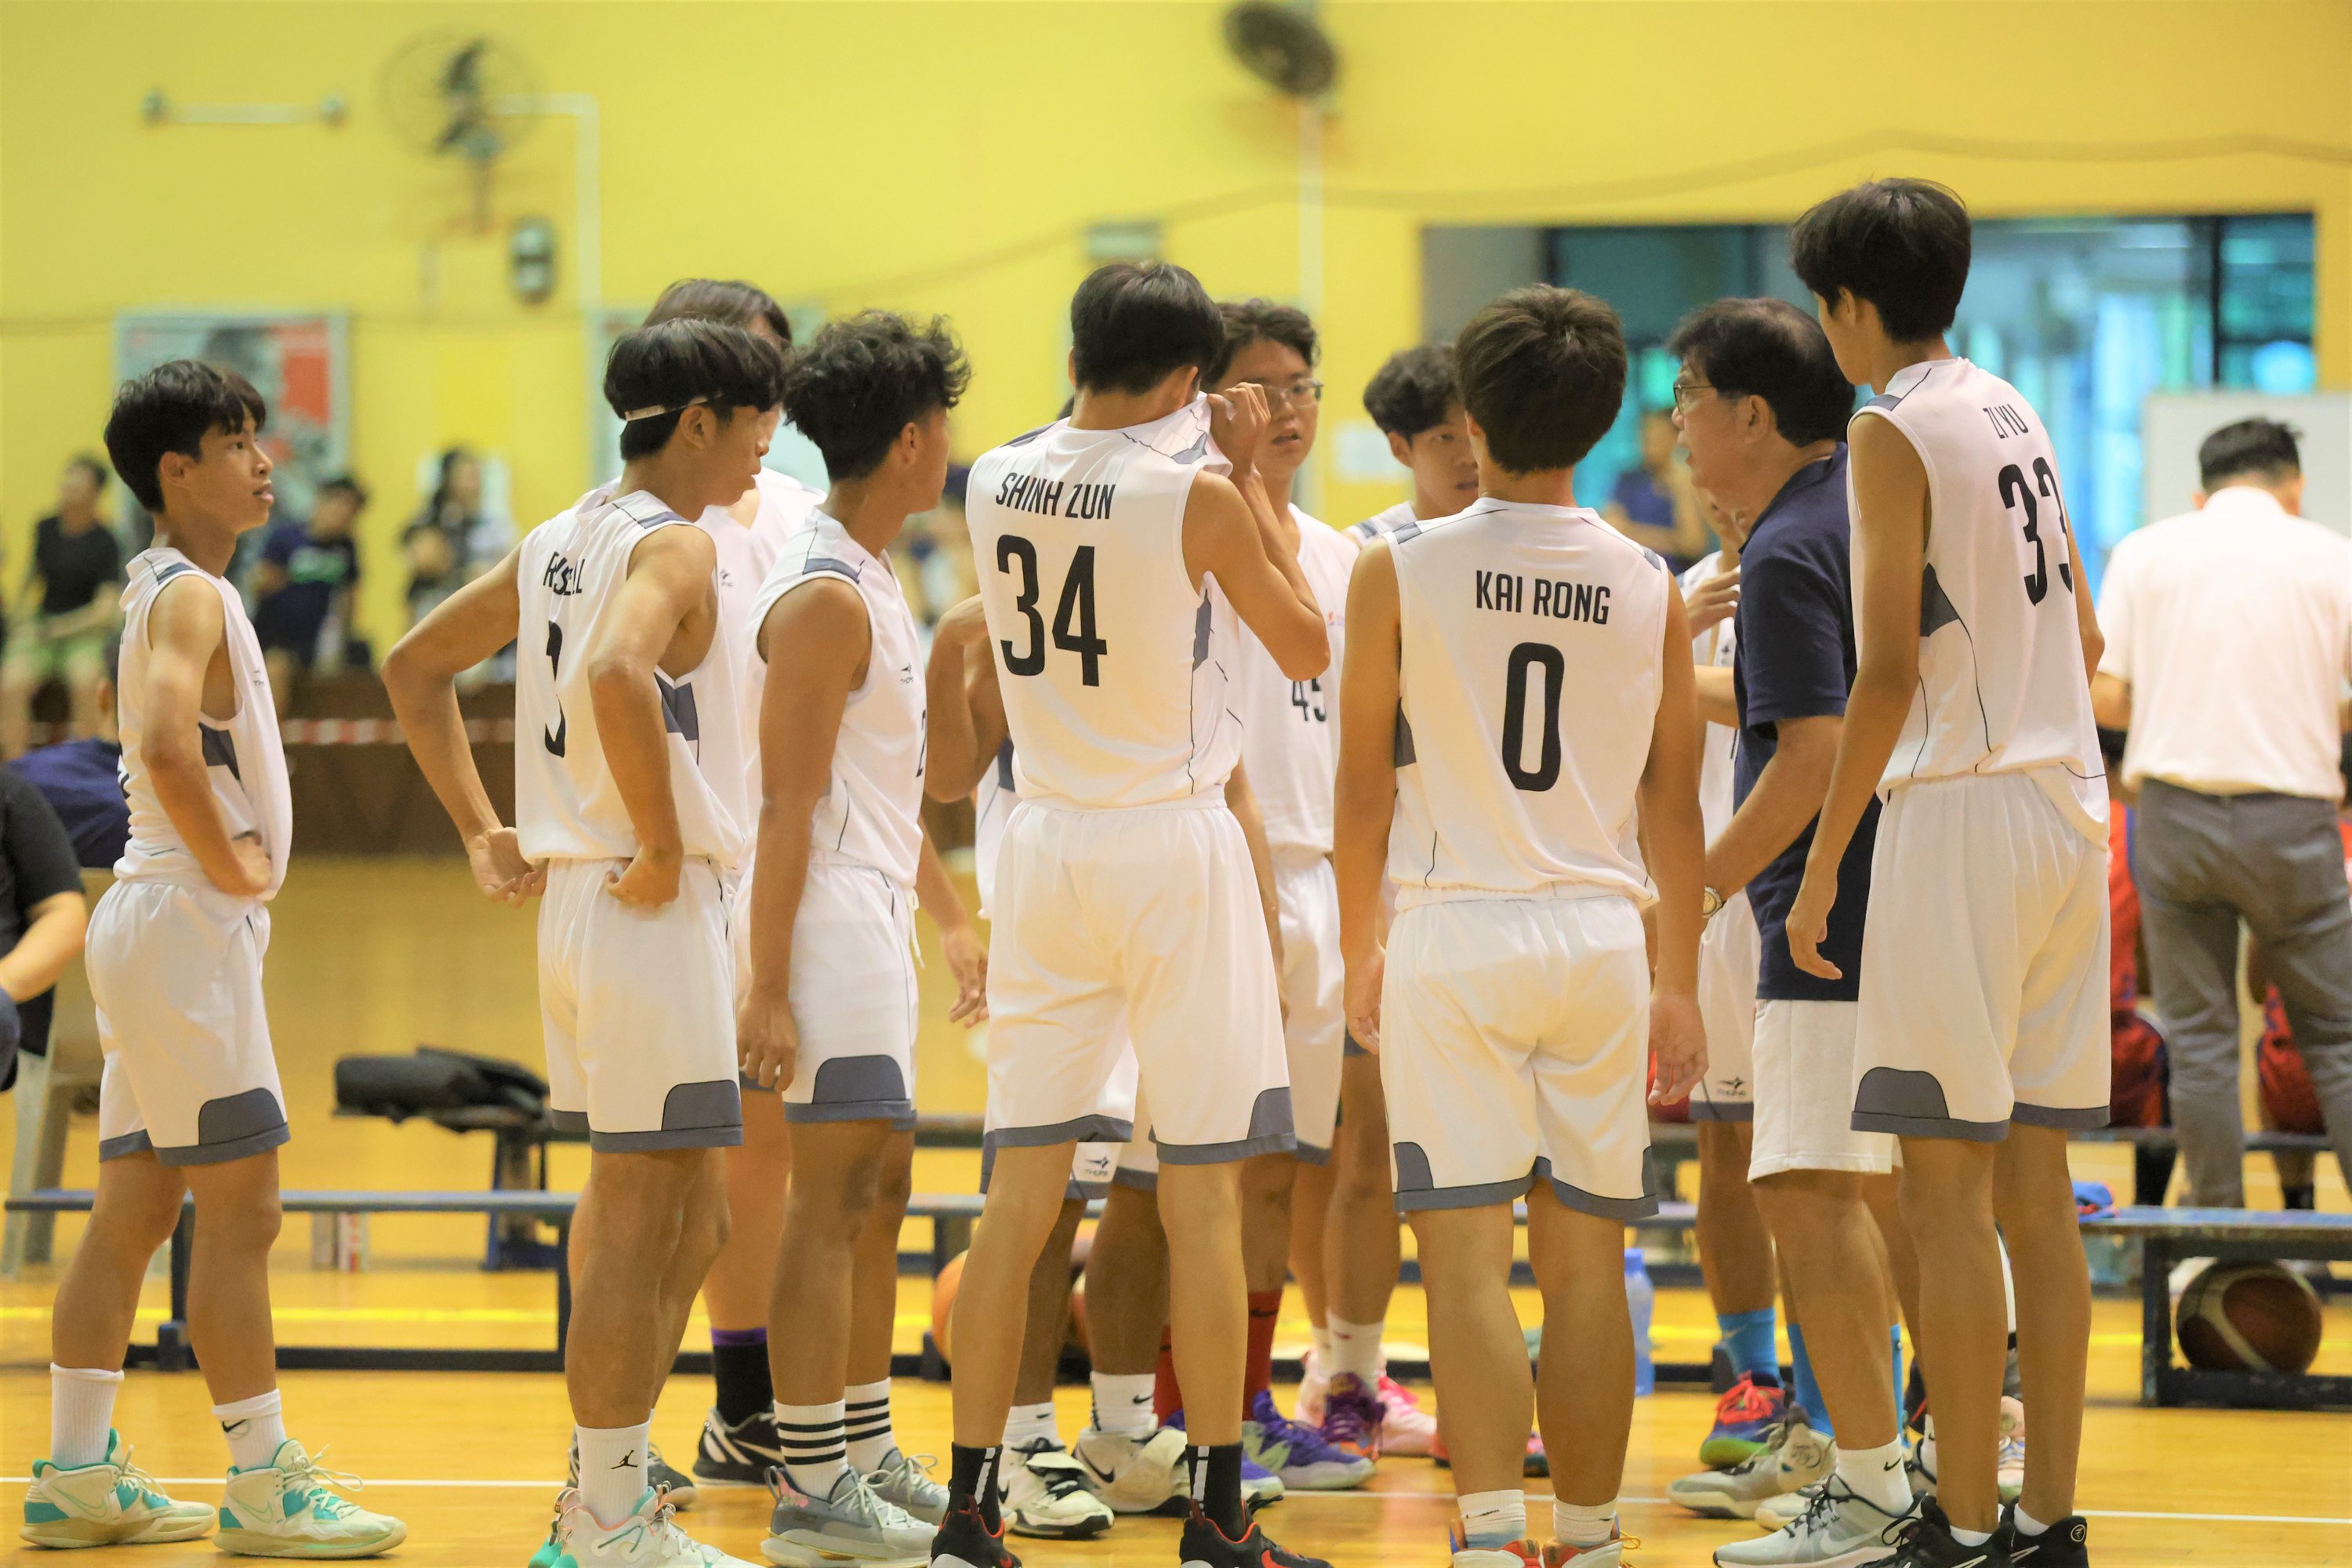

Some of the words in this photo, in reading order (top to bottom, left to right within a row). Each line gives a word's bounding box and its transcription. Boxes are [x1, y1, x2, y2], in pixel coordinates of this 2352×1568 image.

[996, 472, 1064, 517] SHINH
[1065, 483, 1116, 520] ZUN
[1998, 457, 2073, 607] 33
[996, 534, 1108, 687] 34
[1476, 570, 1523, 613] KAI
[1533, 579, 1611, 625] RONG
[1502, 642, 1565, 792] 0
